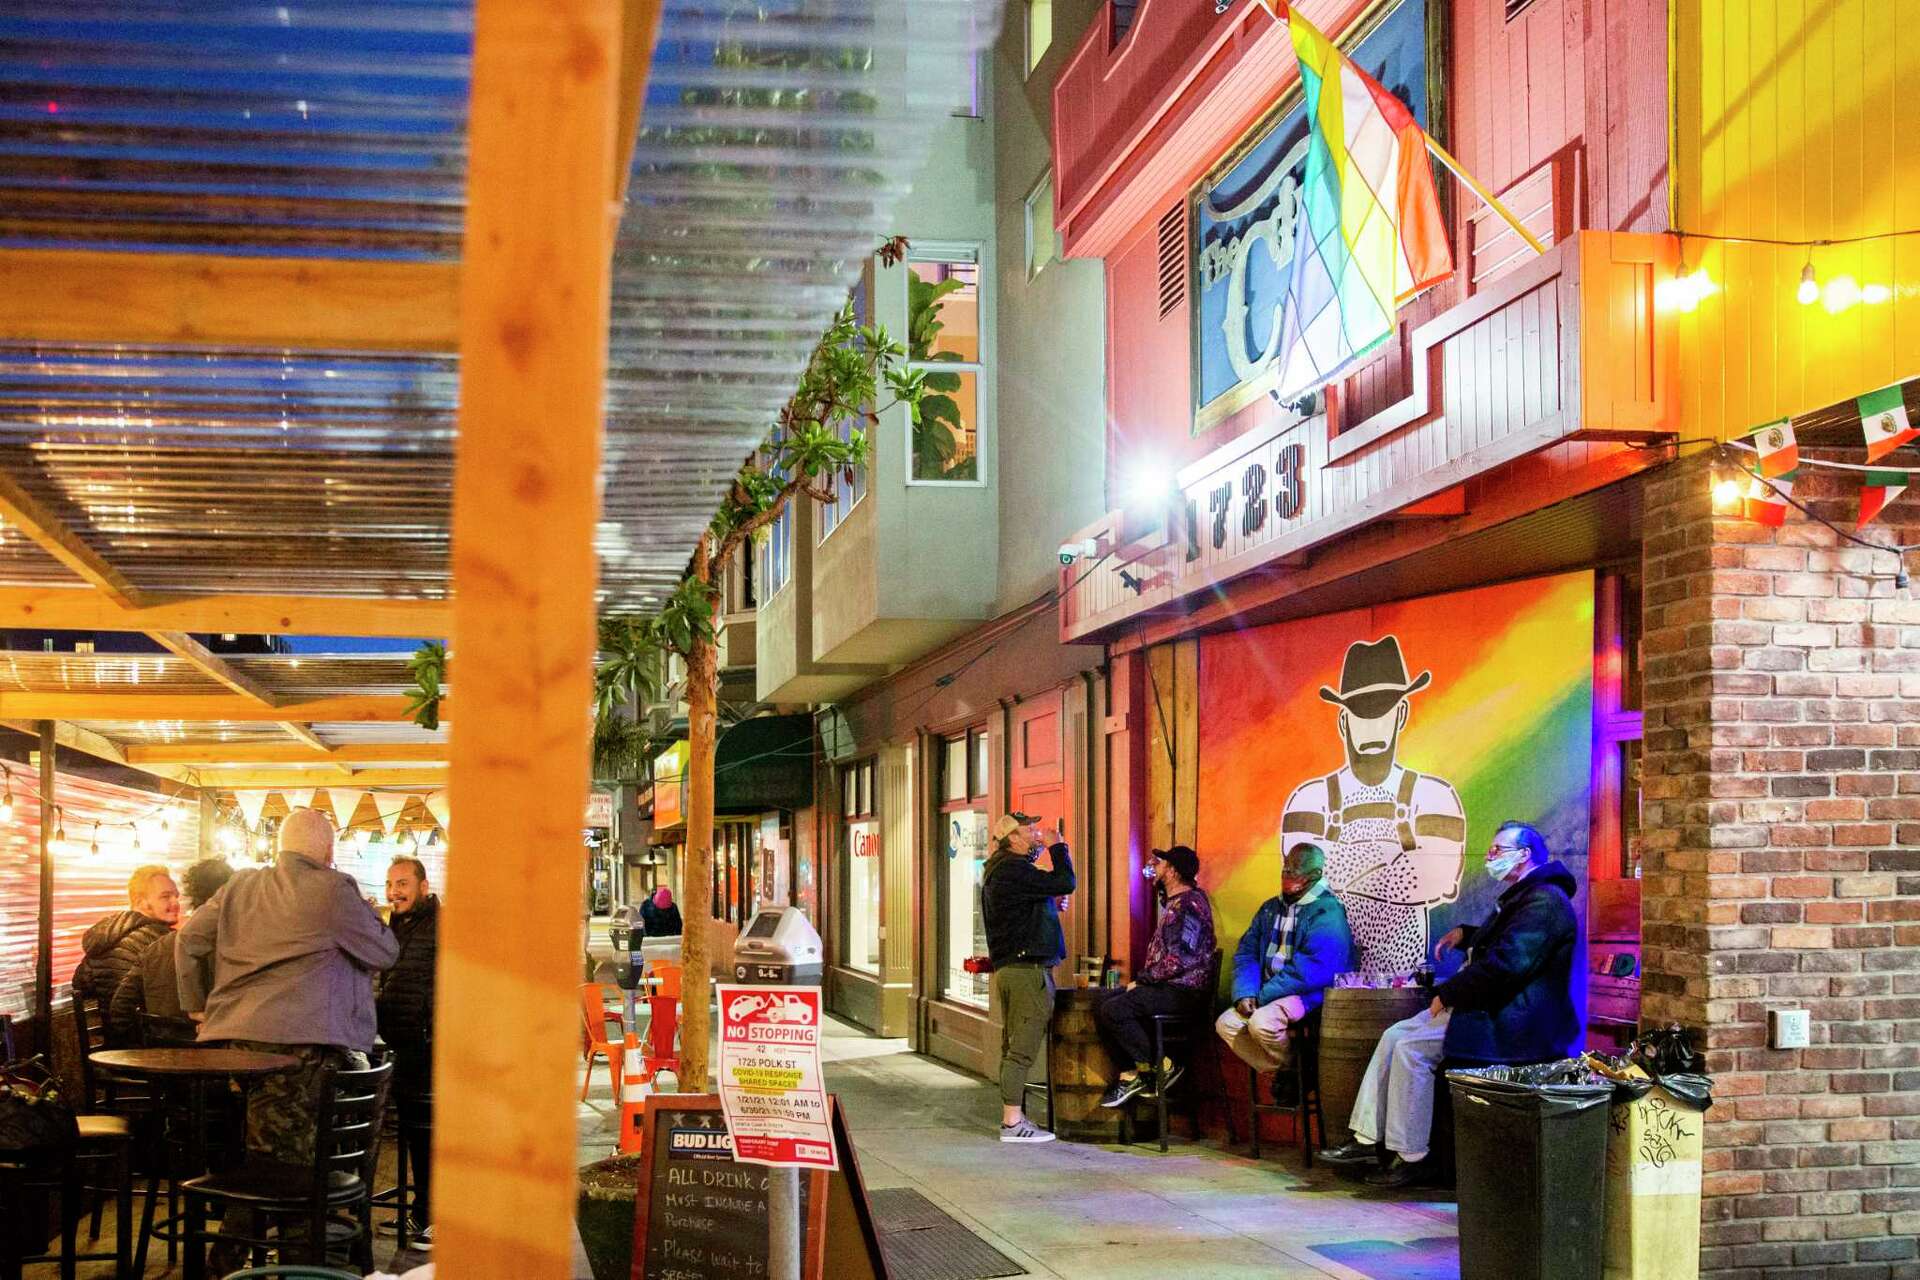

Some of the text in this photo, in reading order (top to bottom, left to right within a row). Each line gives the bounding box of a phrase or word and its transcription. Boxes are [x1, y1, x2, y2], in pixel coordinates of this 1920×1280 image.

[1186, 443, 1306, 563] 1723
[727, 1026, 814, 1041] NO STOPPING
[738, 1058, 797, 1069] 1725 POLK ST
[732, 1068, 803, 1080] COVID-19 RESPONSE
[739, 1077, 797, 1088] SHARED SPACES
[794, 1099, 808, 1108] AM
[810, 1100, 821, 1109] to
[796, 1111, 811, 1120] PM
[673, 1133, 705, 1148] BUD
[668, 1167, 698, 1186] ALL
